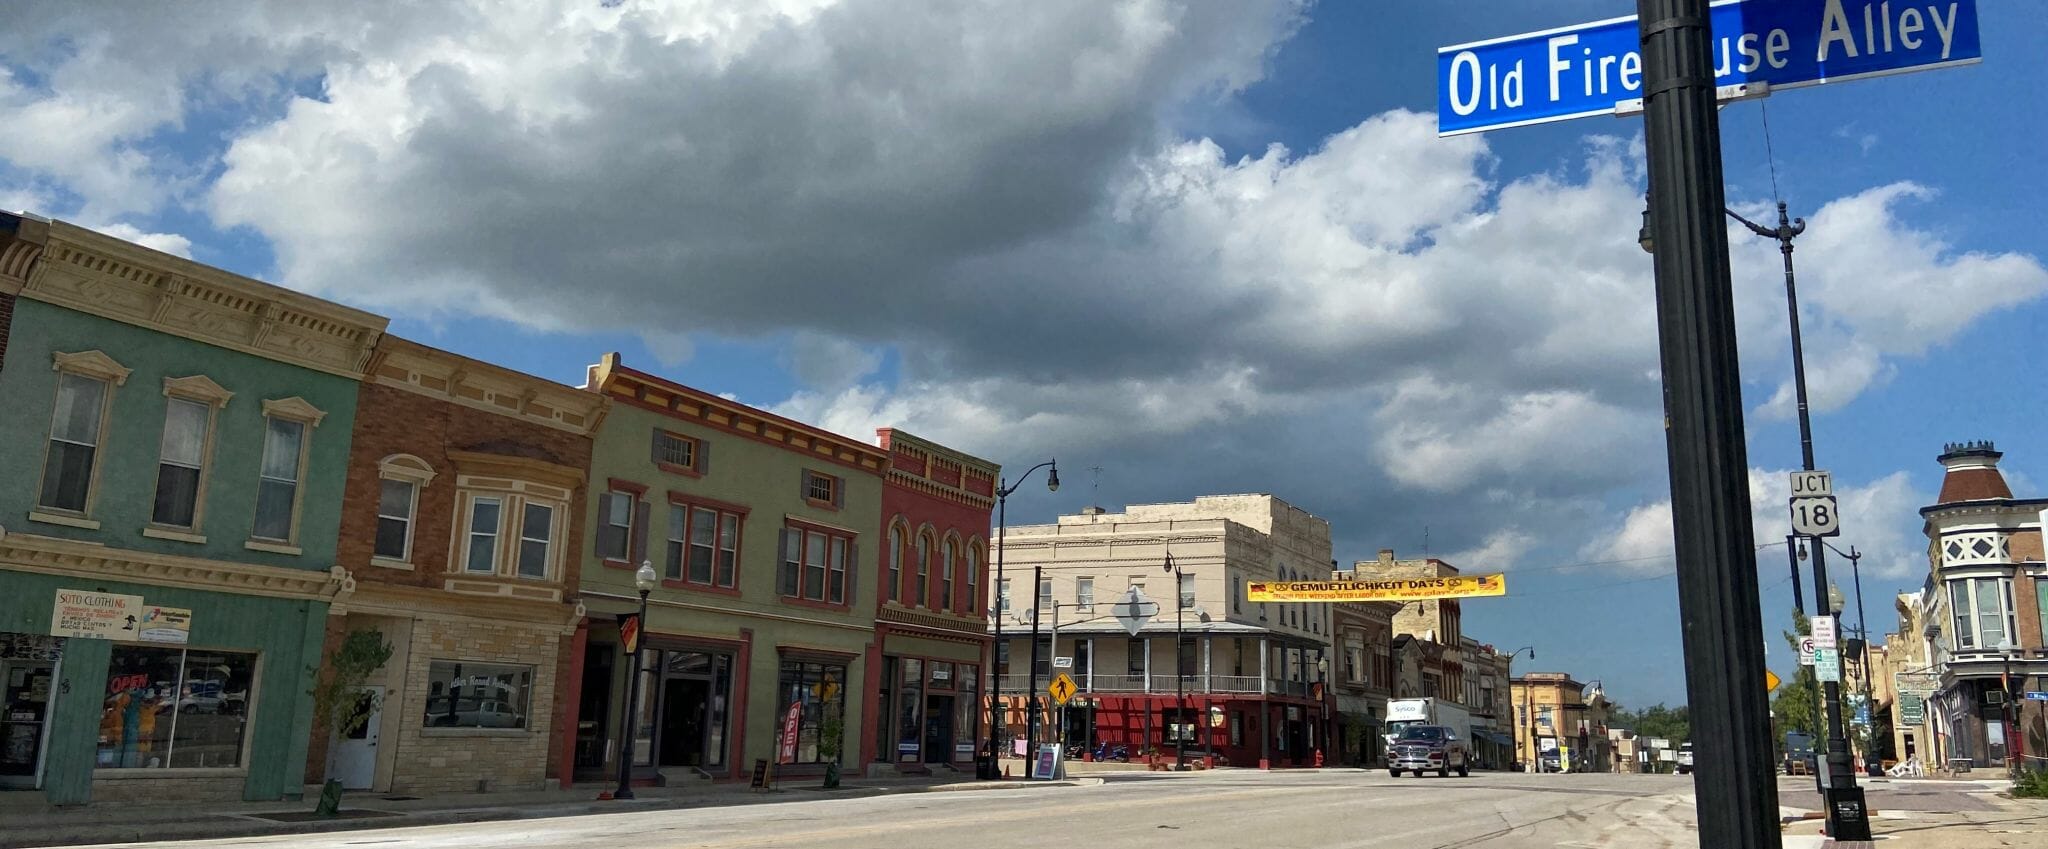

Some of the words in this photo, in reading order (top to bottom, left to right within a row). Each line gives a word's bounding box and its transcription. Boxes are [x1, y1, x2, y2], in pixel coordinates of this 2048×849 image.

[1449, 51, 1523, 115] Old
[1548, 28, 1790, 101] Fireuse
[1817, 0, 1957, 62] Alley
[1795, 475, 1827, 492] JCT
[1799, 505, 1829, 527] 18
[1291, 581, 1405, 591] GEMUETLICHKEIT
[1409, 580, 1444, 588] DAYS
[60, 593, 83, 605] SOTO
[84, 595, 126, 609] CLOTHING
[111, 674, 148, 693] OPEN
[783, 708, 797, 757] OPEN
